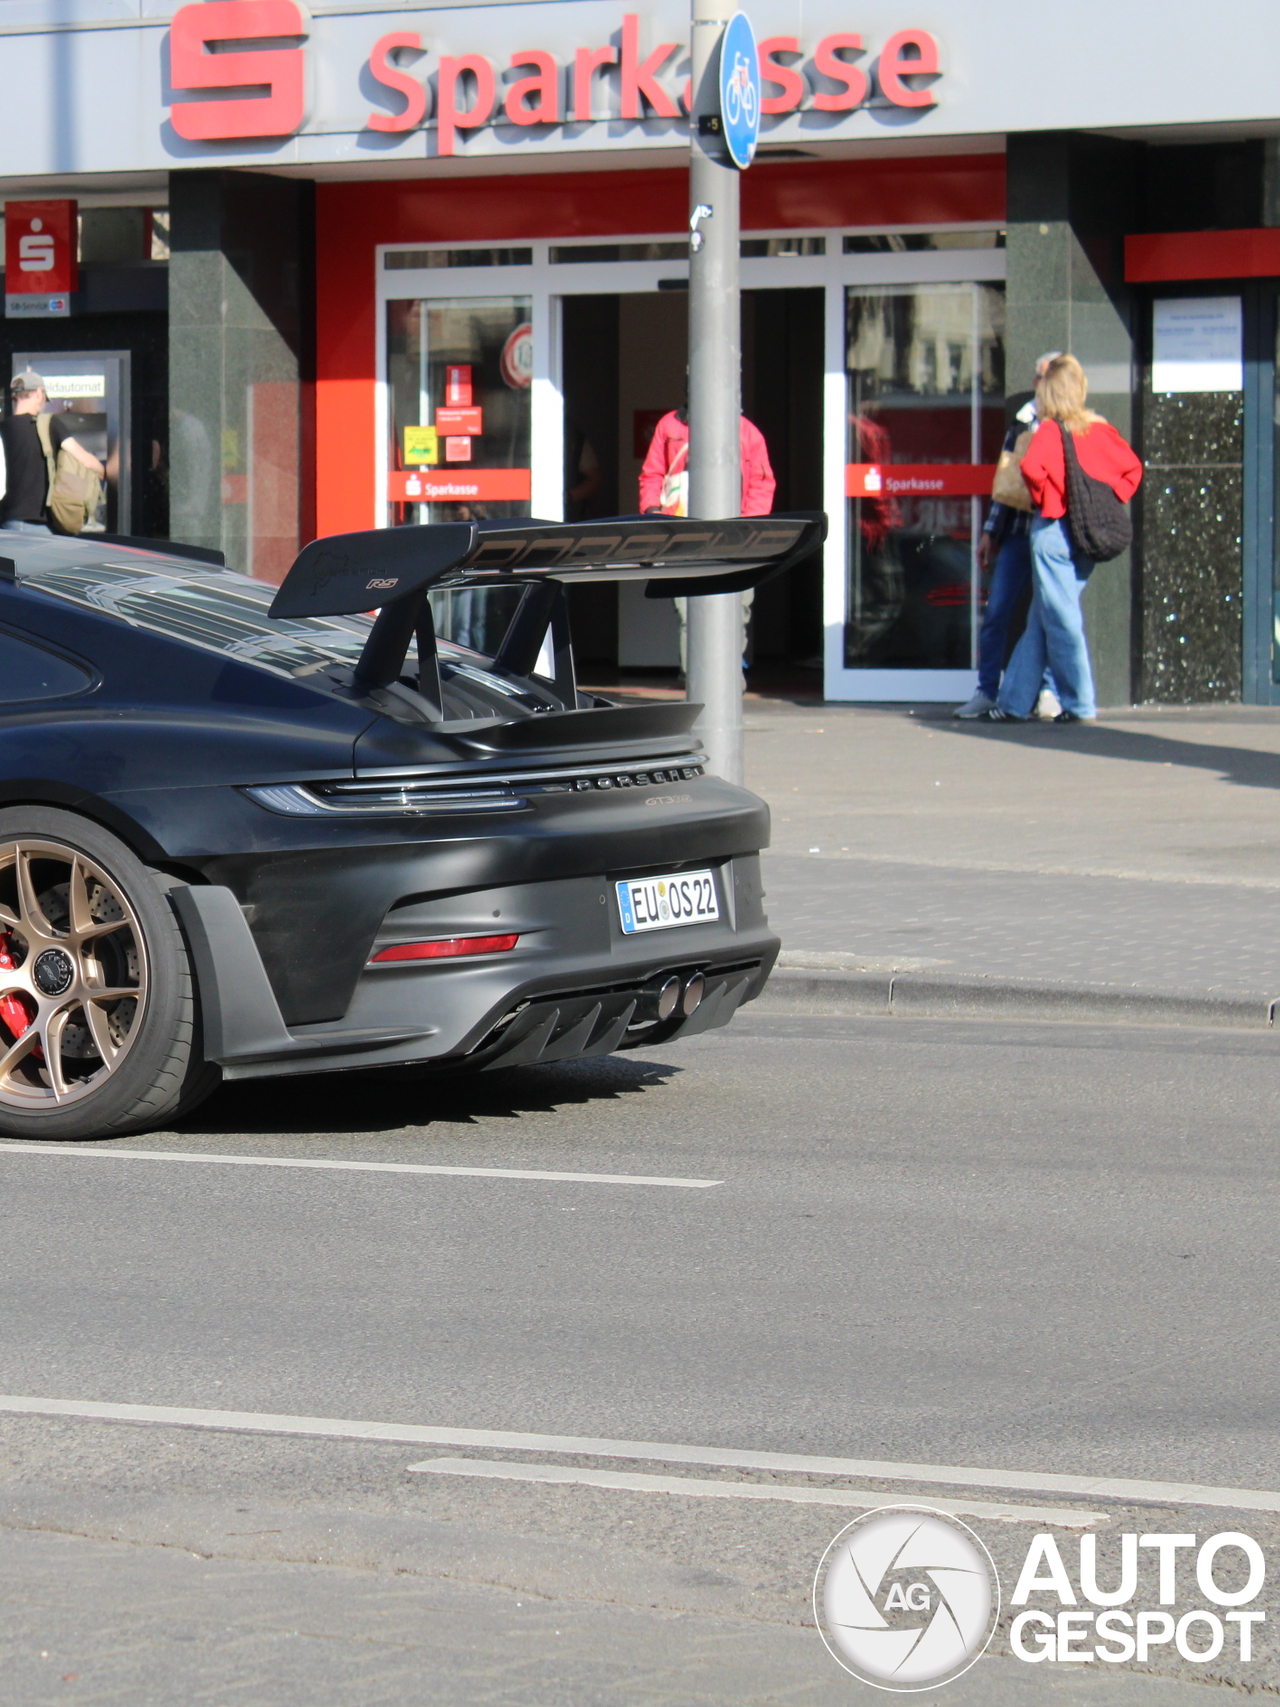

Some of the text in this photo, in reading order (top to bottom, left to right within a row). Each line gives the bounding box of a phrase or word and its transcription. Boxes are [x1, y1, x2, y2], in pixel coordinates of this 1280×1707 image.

[368, 13, 939, 156] Sparksse
[45, 382, 102, 394] eldautomat
[425, 483, 479, 498] Sparkasse
[885, 478, 944, 492] Sparkasse
[365, 578, 399, 589] RS
[576, 767, 694, 791] PORSCHE
[631, 886, 660, 924] EU
